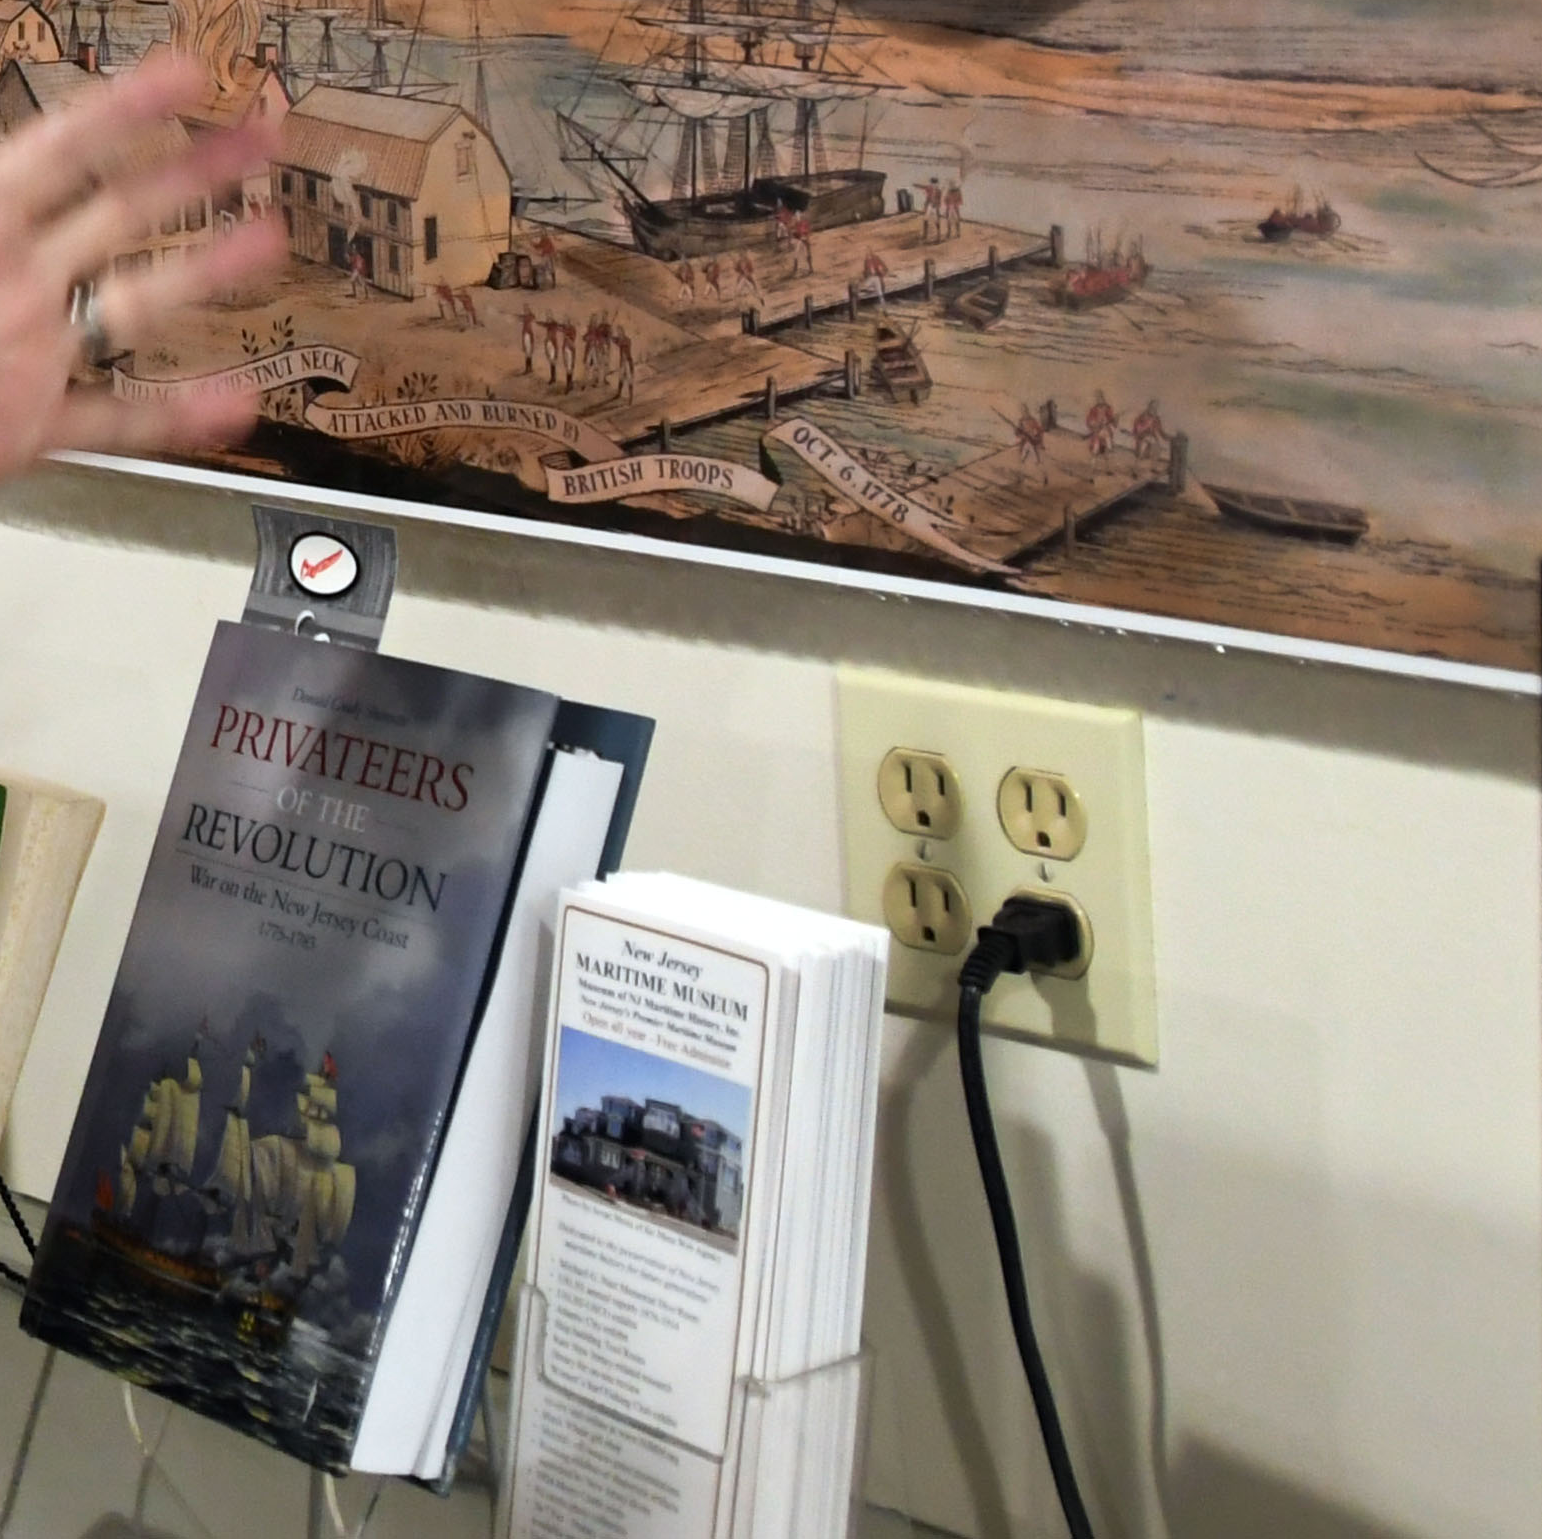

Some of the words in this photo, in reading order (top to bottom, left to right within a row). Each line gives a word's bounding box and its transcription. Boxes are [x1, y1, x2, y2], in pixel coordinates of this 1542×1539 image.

[300, 348, 346, 378] NECK
[326, 401, 428, 434] ATTACKED
[433, 399, 472, 423] AND
[482, 400, 558, 432] BURNED
[563, 460, 644, 497] BRITISH
[655, 458, 735, 490] TROOPS
[792, 425, 834, 469] OCT.
[858, 479, 910, 525] 1778
[210, 703, 475, 813] PRIVATEERS
[276, 785, 312, 817] OF
[316, 794, 371, 833] THE
[182, 802, 448, 914] REVOLUTION
[190, 863, 217, 892] War
[219, 880, 240, 899] on
[243, 881, 268, 906] the
[270, 888, 310, 918] New
[308, 900, 361, 940] Jersey
[361, 918, 411, 949] Coast
[575, 951, 667, 995] MARITIME
[672, 980, 749, 1023] MUSEUM
[622, 939, 655, 963] New
[657, 950, 704, 983] Jersey
